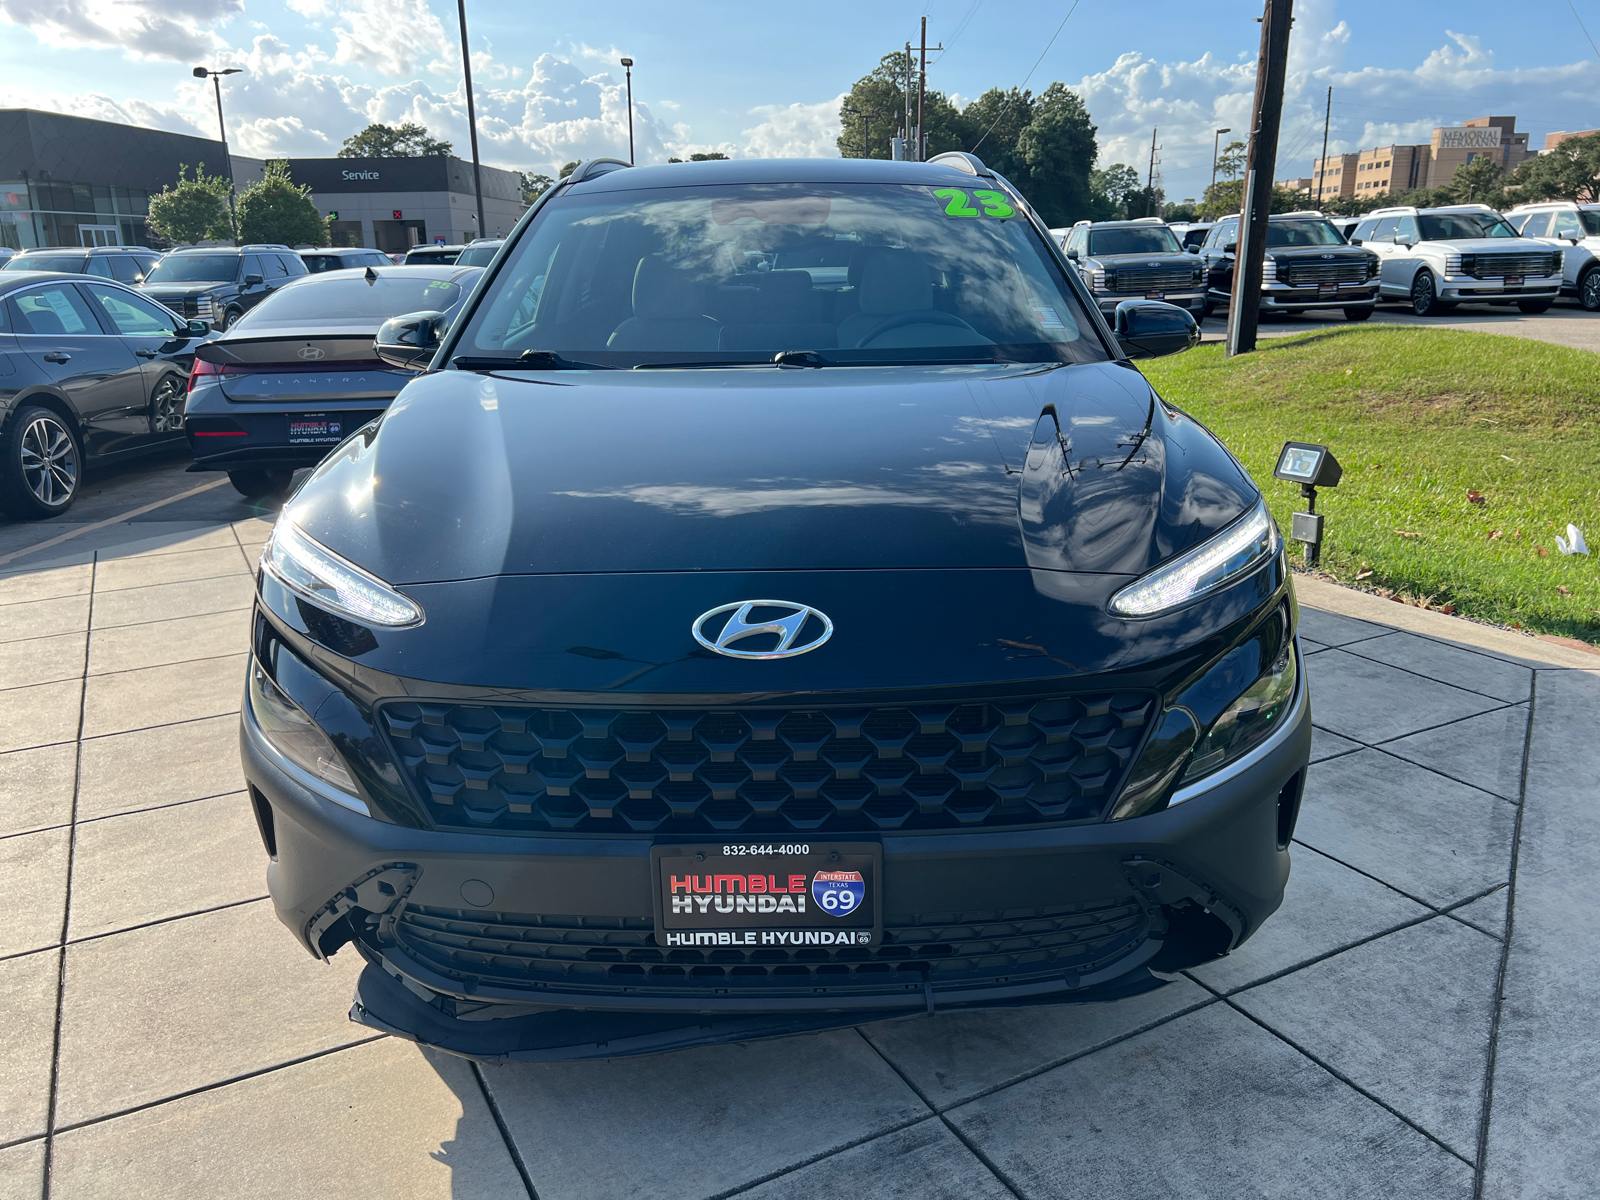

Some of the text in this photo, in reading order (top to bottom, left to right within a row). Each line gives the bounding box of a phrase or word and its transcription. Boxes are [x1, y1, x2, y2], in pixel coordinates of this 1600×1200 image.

[1443, 130, 1498, 140] MEMORIAL
[1442, 139, 1497, 147] HERMANN
[341, 170, 380, 180] Service
[933, 188, 1016, 219] 23
[428, 280, 452, 289] 25
[290, 427, 328, 435] HYUNDAI
[722, 844, 810, 856] 832-644-4000
[820, 873, 856, 881] INTERSTATE
[670, 874, 807, 894] HUMBLE
[671, 894, 807, 914] HYUNDAI
[821, 890, 855, 910] 69
[666, 931, 757, 946] HUMBLE
[761, 931, 856, 945] HYUNDAI
